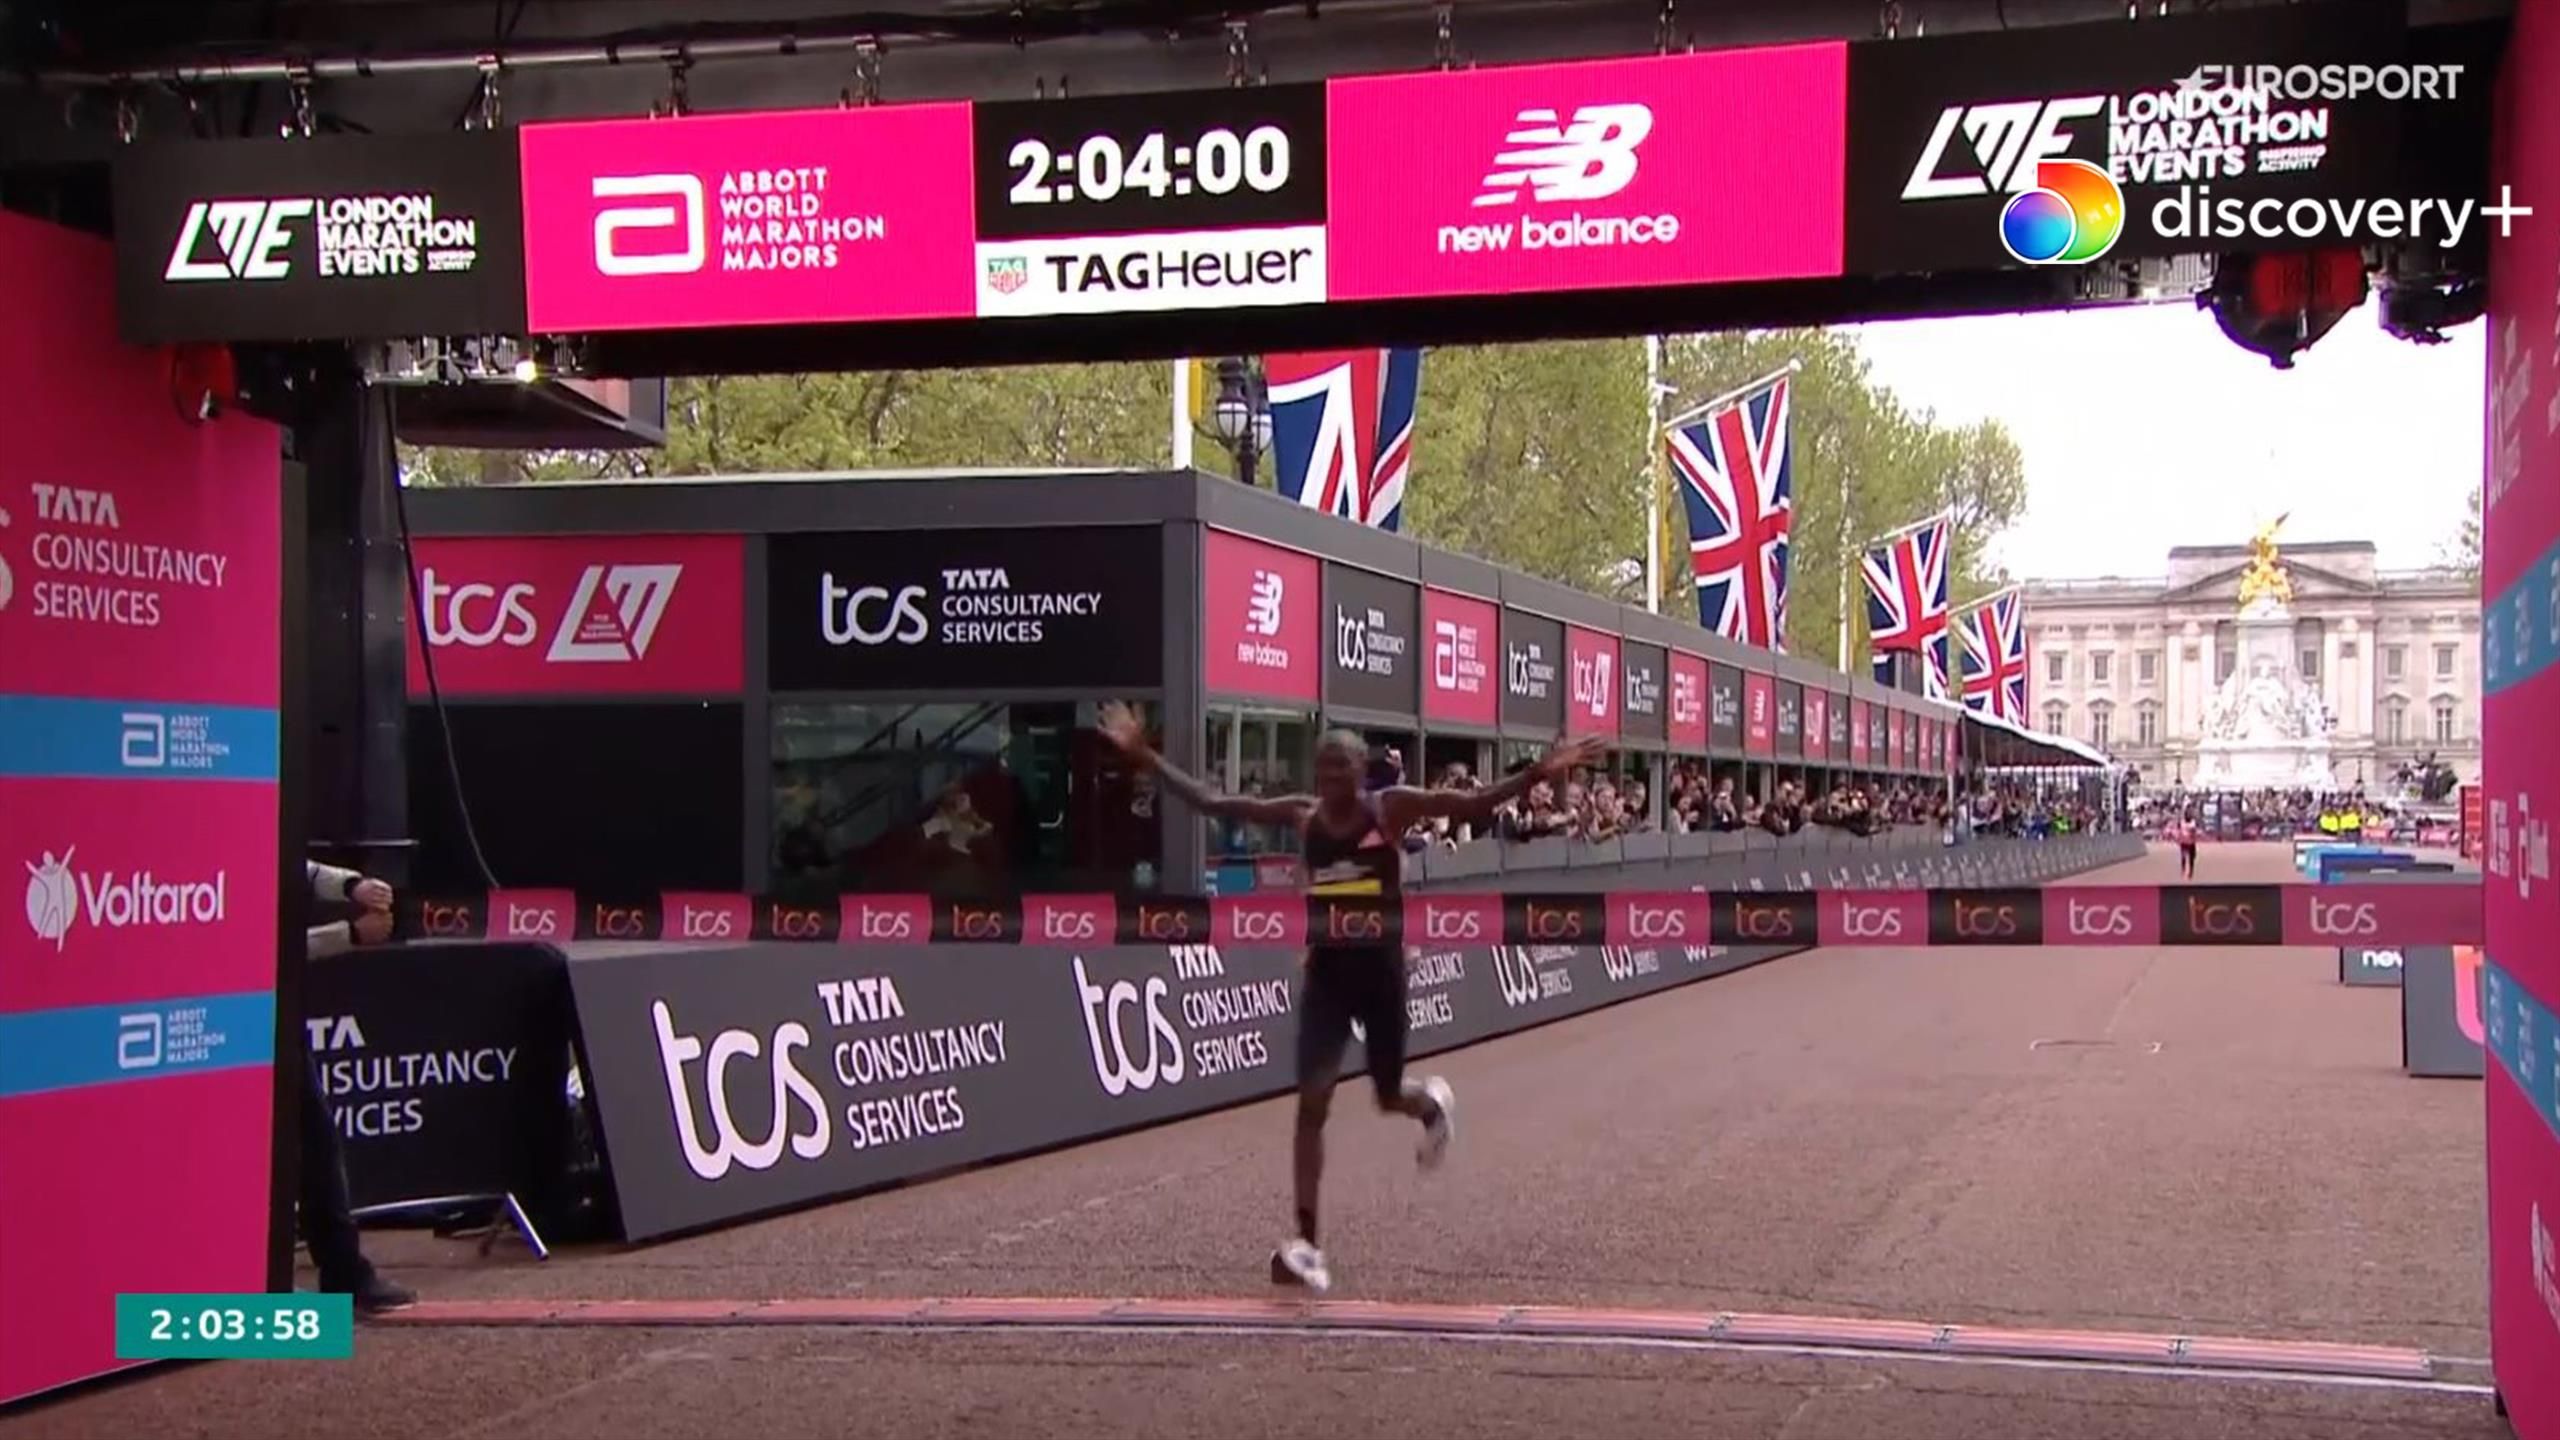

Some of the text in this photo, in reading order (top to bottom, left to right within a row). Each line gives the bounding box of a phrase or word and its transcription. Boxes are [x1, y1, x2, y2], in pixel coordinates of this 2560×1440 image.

[2108, 86, 2269, 124] LONDON
[2108, 109, 2329, 156] MARATHON
[720, 167, 828, 194] ABBOTT
[1008, 125, 1290, 204] 2:04:00
[2108, 146, 2246, 183] EVENTS
[316, 195, 432, 225] LONDON
[720, 193, 820, 220] WORLD
[317, 220, 476, 250] MARATHON
[721, 215, 885, 246] MARATHON
[1438, 211, 1681, 253] new balance
[318, 248, 419, 277] EVENTS
[722, 244, 839, 271] MAJORS
[31, 482, 120, 529] TATA
[32, 532, 227, 588] CONSULTANCY
[941, 567, 1011, 591] TATA
[33, 581, 160, 627] SERVICES
[423, 567, 538, 647] tcs
[821, 571, 930, 645] tcs
[941, 592, 1102, 618] CONSULTANCY
[941, 620, 1044, 644] SERVICES
[1336, 603, 1366, 671] tcs
[1507, 640, 1529, 697] tcs
[80, 869, 225, 928] Voltarol
[423, 896, 2378, 939] tcs tcs tcs tcs tcs tcs tcs tcs tcs tcs tcs tcs tcs tcs tcs tcs tcs tcs tcs tcs
[1169, 944, 1224, 980] TATA
[817, 976, 905, 1027] TATA
[1182, 979, 1292, 1029] CONSULTANCY
[1406, 992, 1454, 1031] SERVICES
[306, 1014, 366, 1051] TA
[1073, 955, 1185, 1095] tcs
[321, 1047, 517, 1096] SULTANCY
[834, 1021, 1007, 1087] CONSULTANCY
[1193, 1030, 1269, 1078] SERVICES
[652, 999, 831, 1181] tcs
[847, 1087, 964, 1150] SERVICES
